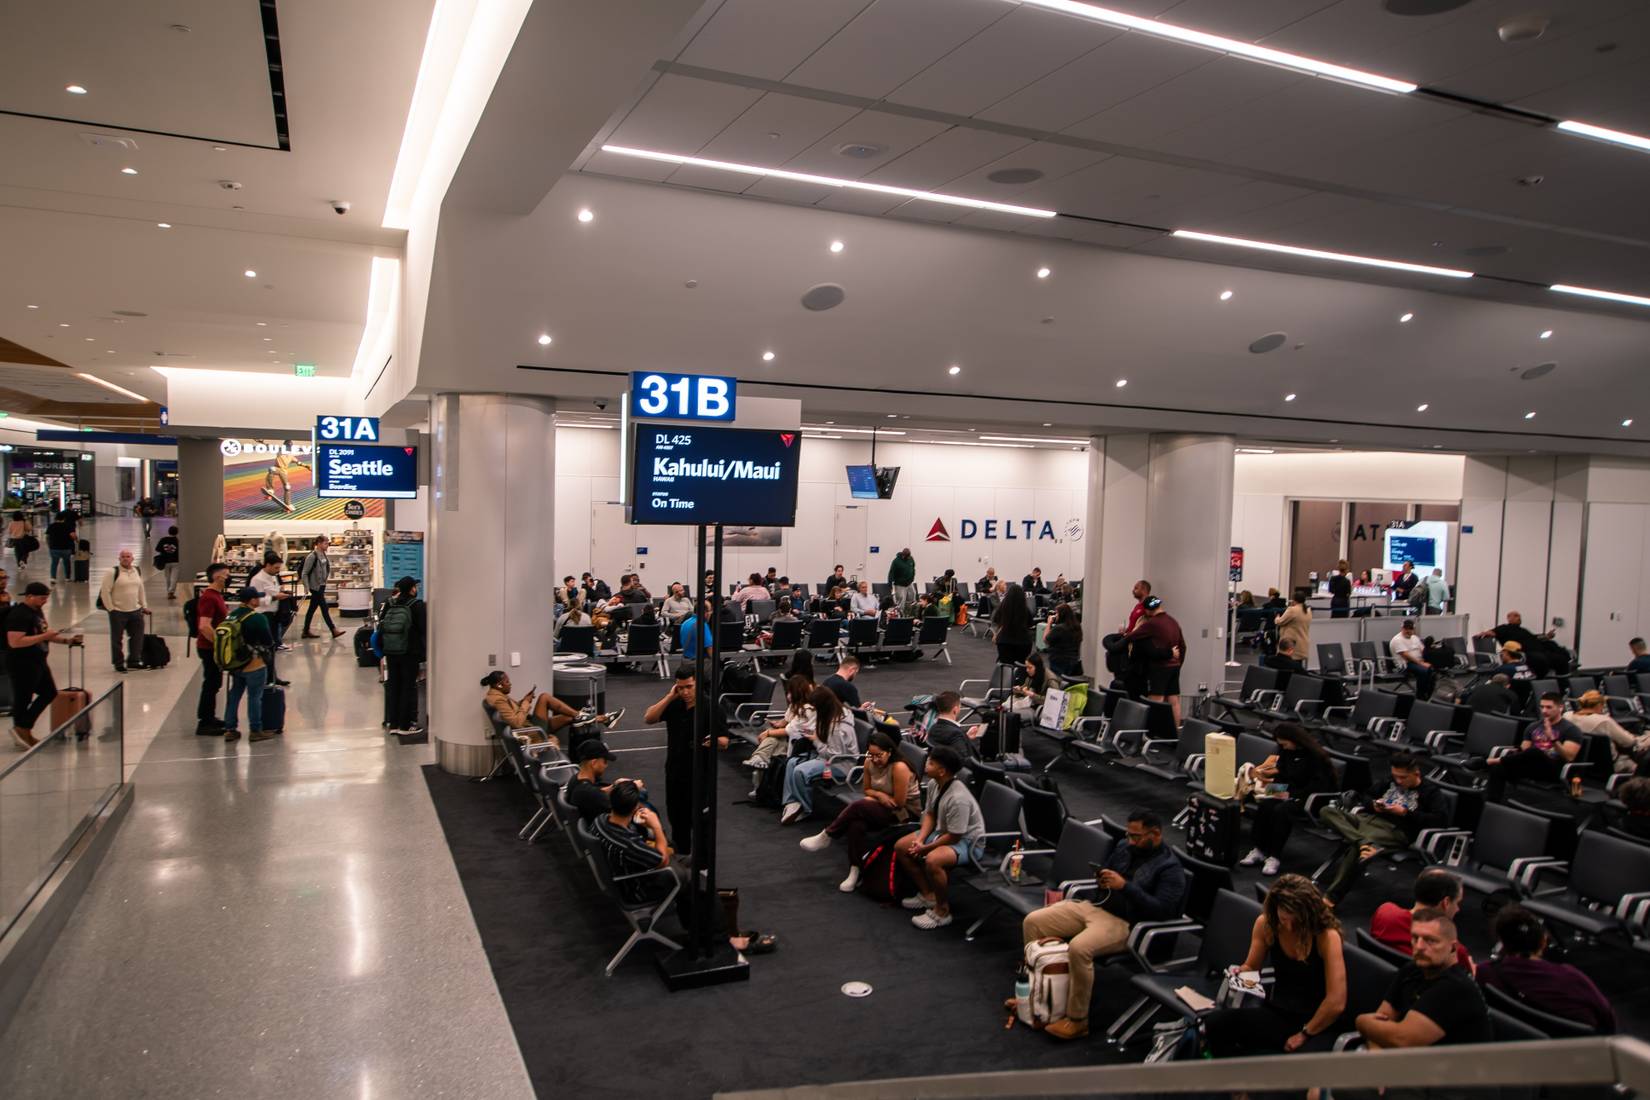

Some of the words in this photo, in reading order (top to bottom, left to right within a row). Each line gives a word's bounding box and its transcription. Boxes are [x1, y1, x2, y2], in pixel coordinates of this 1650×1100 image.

[639, 375, 730, 417] 31B
[320, 416, 377, 440] 31A
[242, 443, 320, 455] BOULEV
[655, 433, 670, 445] DL
[671, 434, 692, 446] 425
[328, 458, 394, 477] Seattle
[653, 456, 782, 481] Kahului/Maui
[651, 498, 668, 509] On
[669, 498, 695, 509] Time
[960, 518, 1056, 541] DELTA
